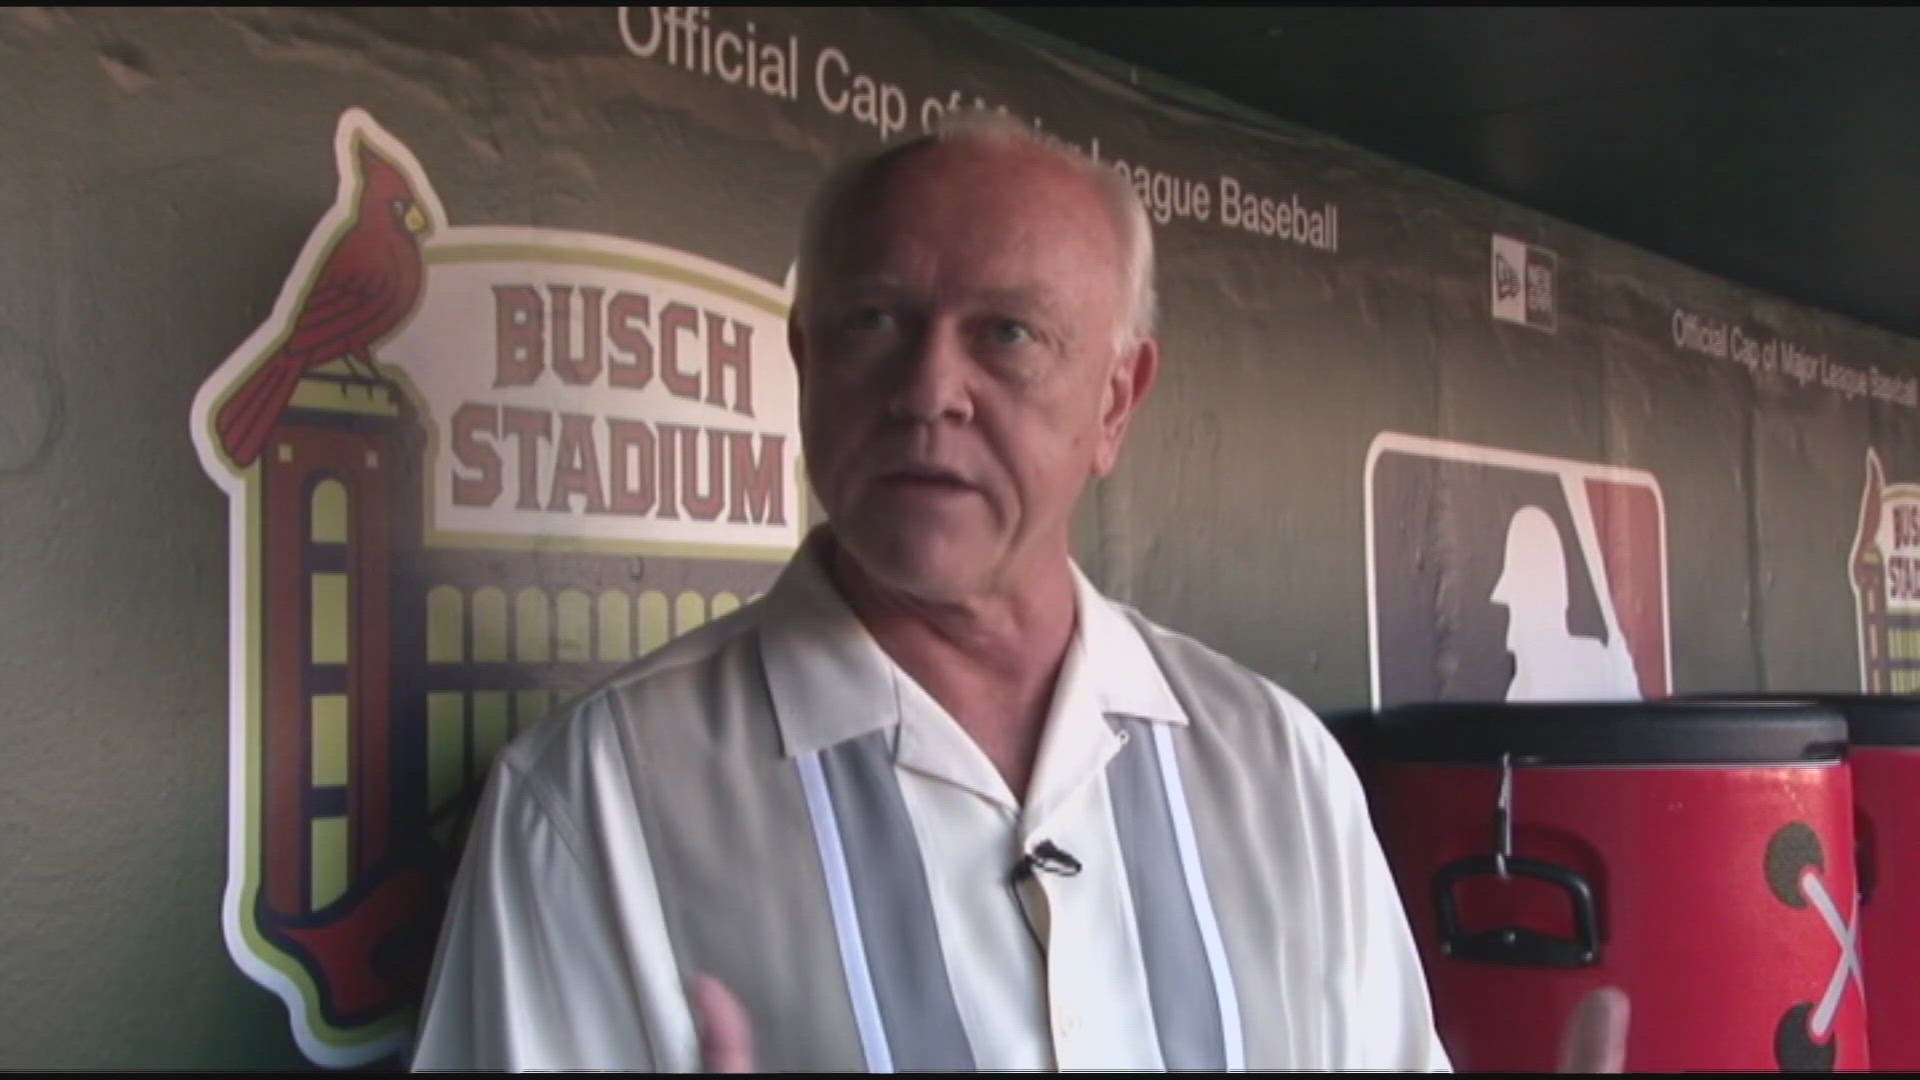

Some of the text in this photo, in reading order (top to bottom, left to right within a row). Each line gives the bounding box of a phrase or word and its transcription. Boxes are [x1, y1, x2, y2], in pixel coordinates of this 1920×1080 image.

[617, 7, 799, 101] Official
[814, 47, 908, 143] Cap
[1219, 174, 1338, 253] Baseball
[491, 283, 755, 419] BUSCH
[451, 402, 787, 526] STADIUM
